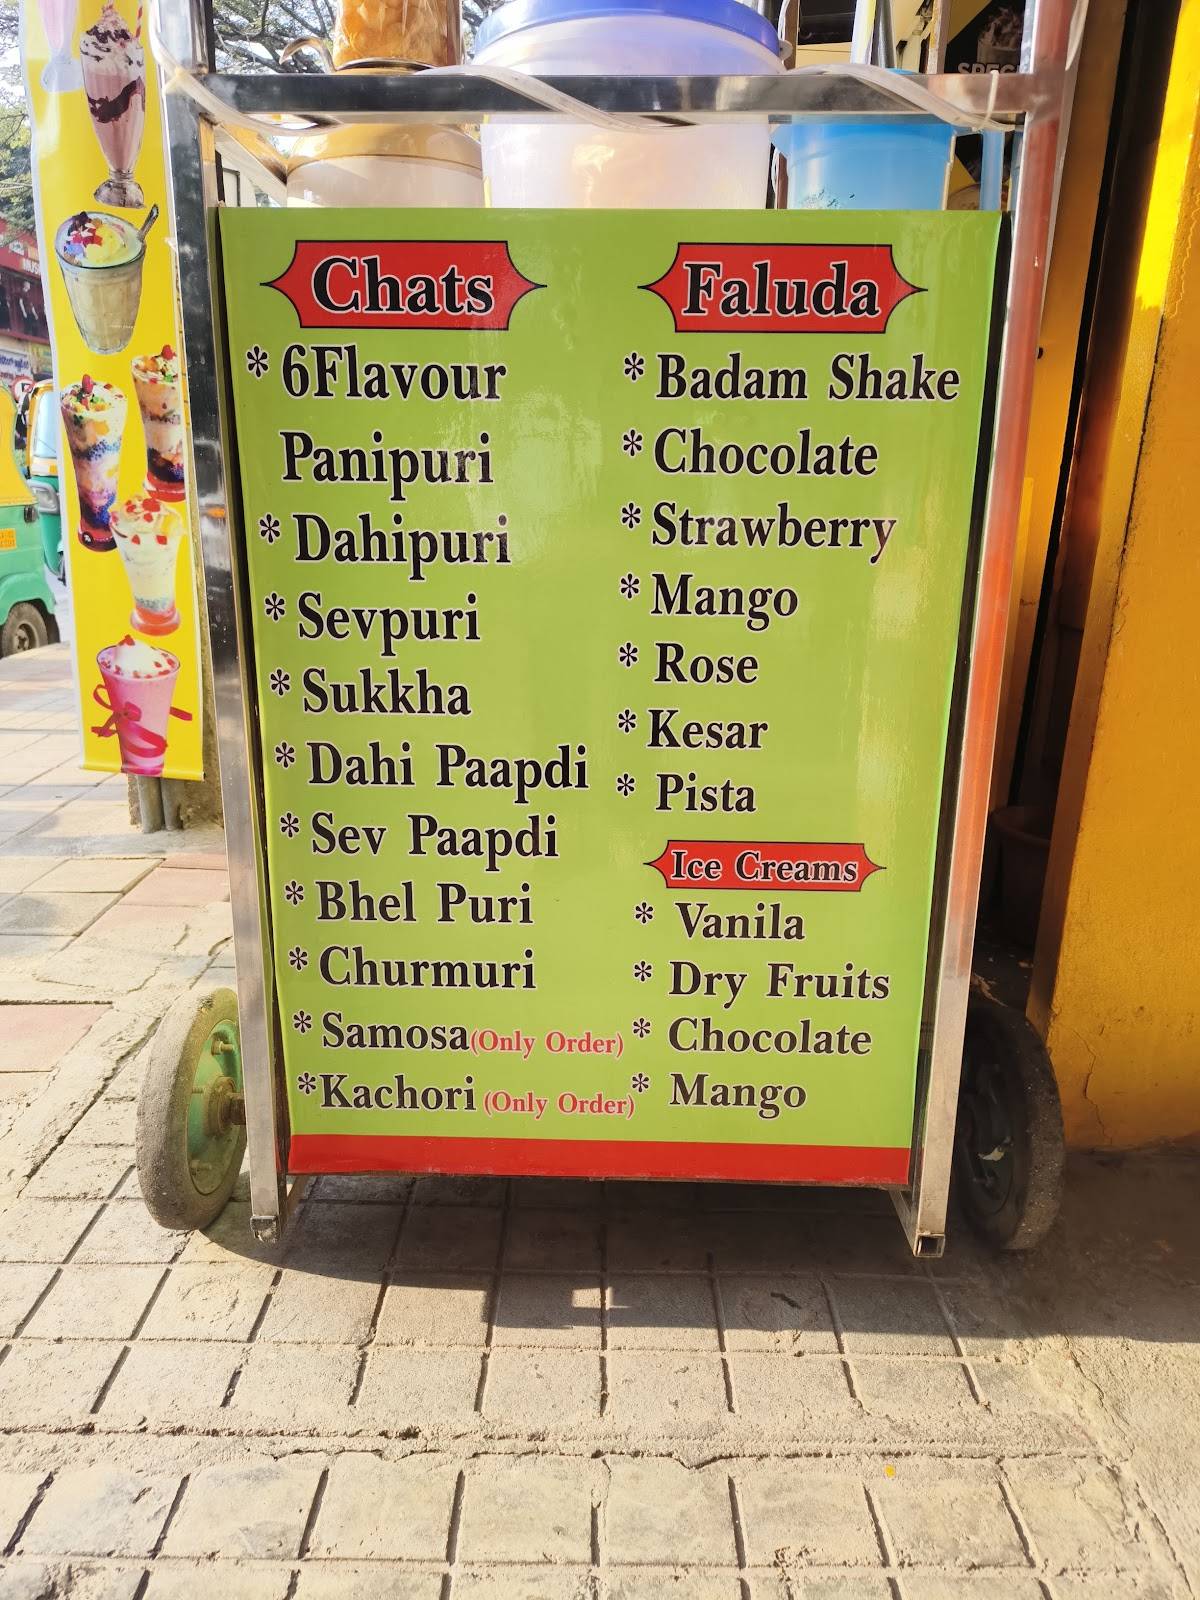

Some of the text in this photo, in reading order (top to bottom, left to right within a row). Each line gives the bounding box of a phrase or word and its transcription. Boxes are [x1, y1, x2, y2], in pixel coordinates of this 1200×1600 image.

[313, 257, 493, 314] Chats
[683, 262, 880, 316] Faluda
[282, 344, 507, 400] 6Flavour
[656, 352, 960, 401] Badam Shake
[279, 431, 494, 502] Panipuri
[654, 427, 878, 476] Chocolate
[292, 513, 511, 581] Dahipuri
[652, 501, 897, 564] Strawberry
[298, 592, 481, 657] Sevpuri
[650, 573, 798, 632] Mango
[654, 642, 758, 684] Rose
[303, 667, 472, 715] Sukkha
[647, 709, 769, 749] Kesar
[306, 741, 589, 804] Dahi Paapdi
[655, 772, 757, 813] Pista
[311, 812, 559, 872] Sev Paapdi
[671, 851, 857, 882] Ice Creams
[315, 880, 534, 924] Bhel Puri
[674, 902, 806, 940] Vanila
[319, 945, 537, 989] Churmuri
[668, 961, 889, 1009] Dry Fruits
[322, 1012, 624, 1058] Samosa (Only Order)
[668, 1017, 872, 1055] Chocolate
[318, 1074, 634, 1119] Kachori (Only Order)
[669, 1073, 807, 1119] Mango
